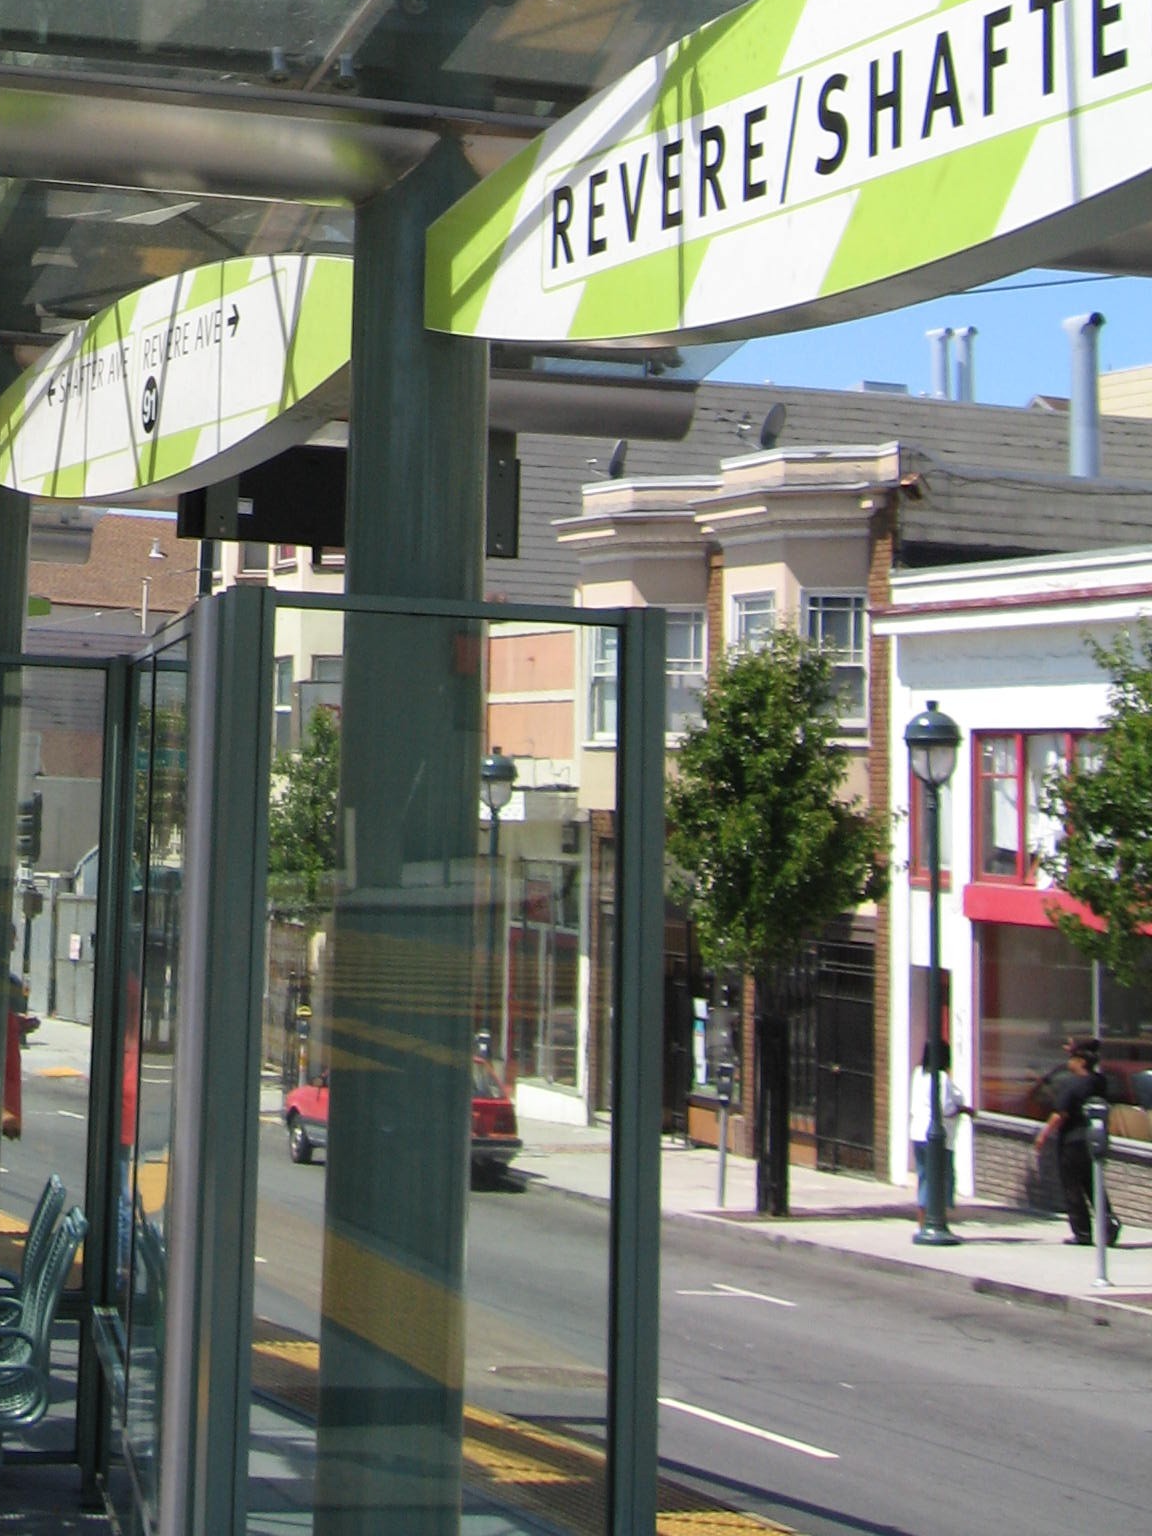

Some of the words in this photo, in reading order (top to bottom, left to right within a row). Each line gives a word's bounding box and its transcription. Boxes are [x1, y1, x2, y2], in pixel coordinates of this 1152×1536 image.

[144, 323, 190, 369] REVERE
[195, 310, 222, 350] AVE
[58, 358, 105, 404] SHAFTER
[108, 347, 130, 384] AVE
[142, 386, 158, 425] 91
